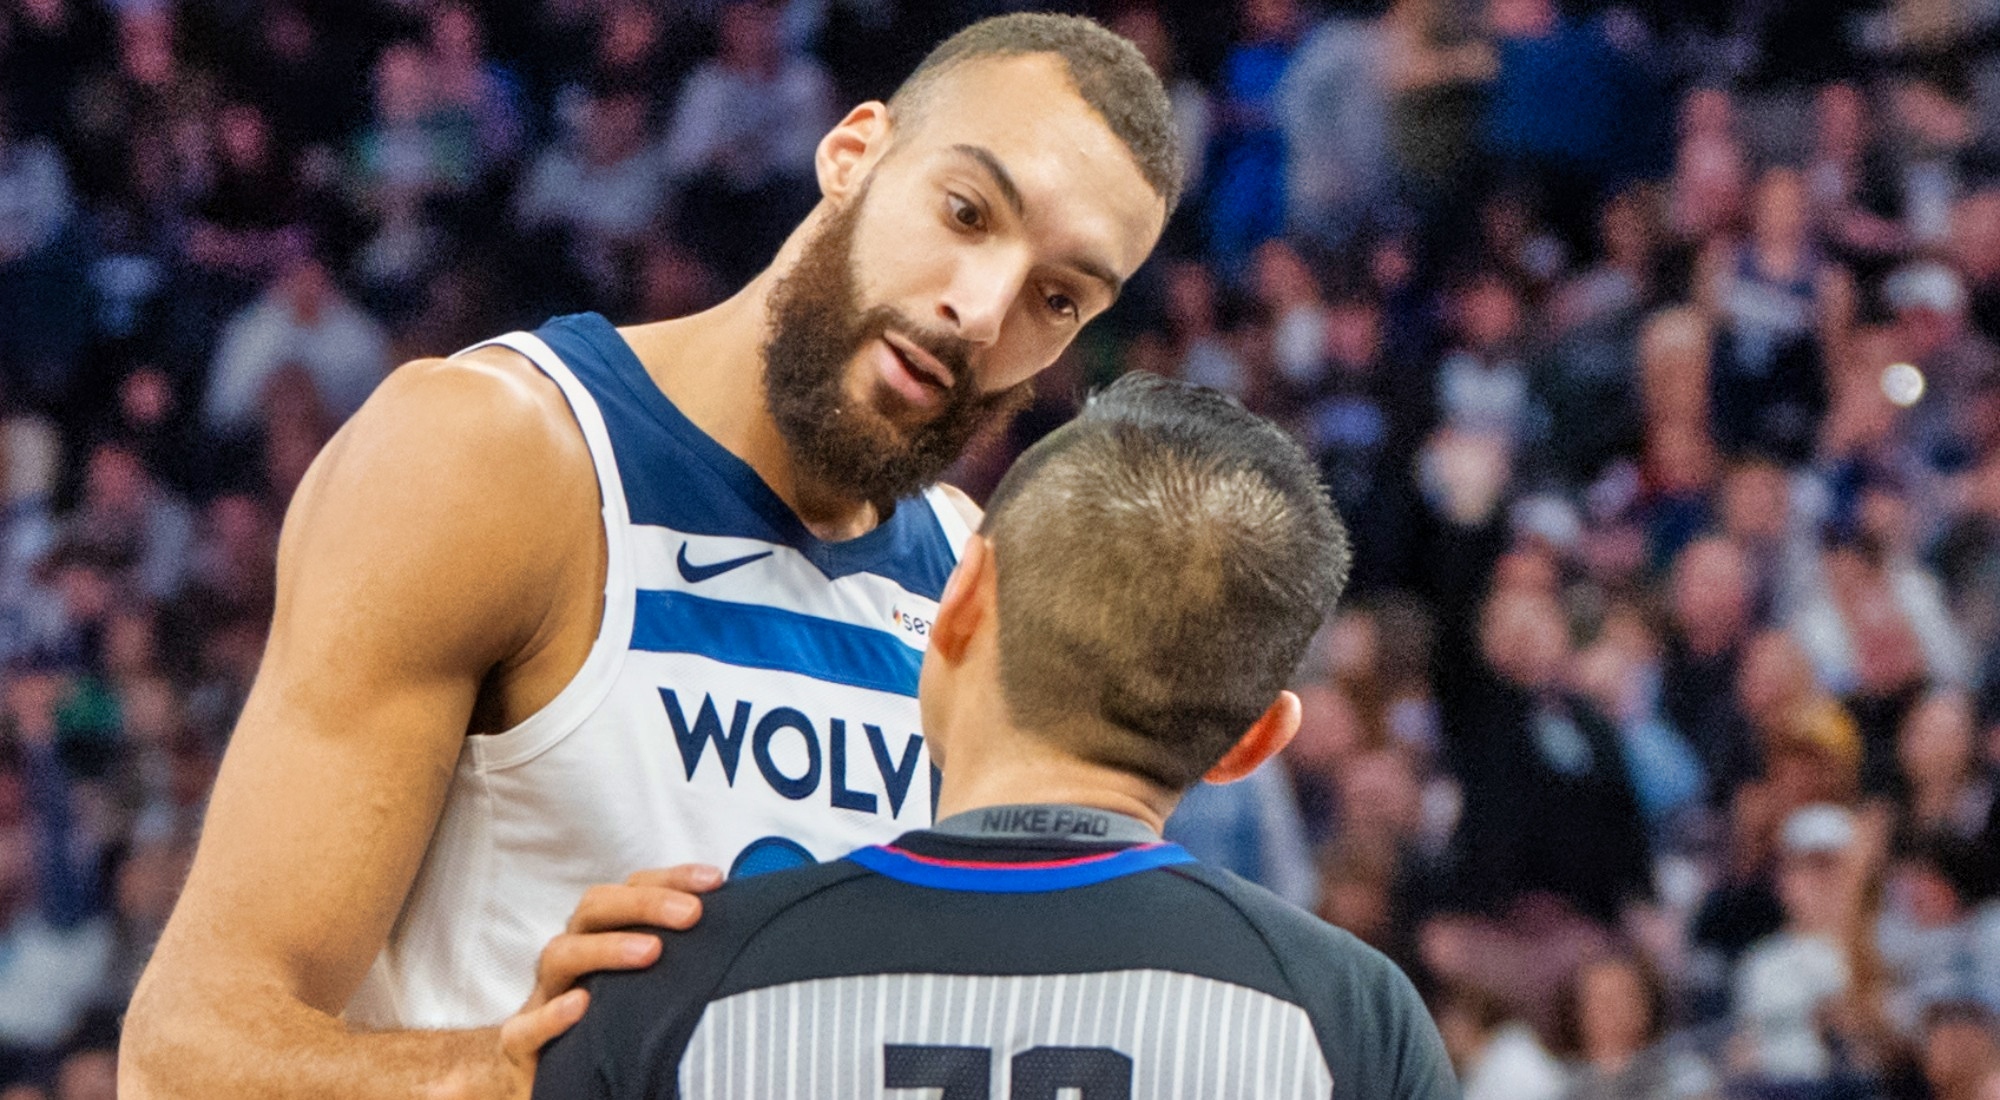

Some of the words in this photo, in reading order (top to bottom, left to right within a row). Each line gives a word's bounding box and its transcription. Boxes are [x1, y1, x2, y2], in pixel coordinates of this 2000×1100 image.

[657, 686, 942, 827] WOLV
[980, 808, 1050, 833] NIKE
[1053, 809, 1109, 837] PRO
